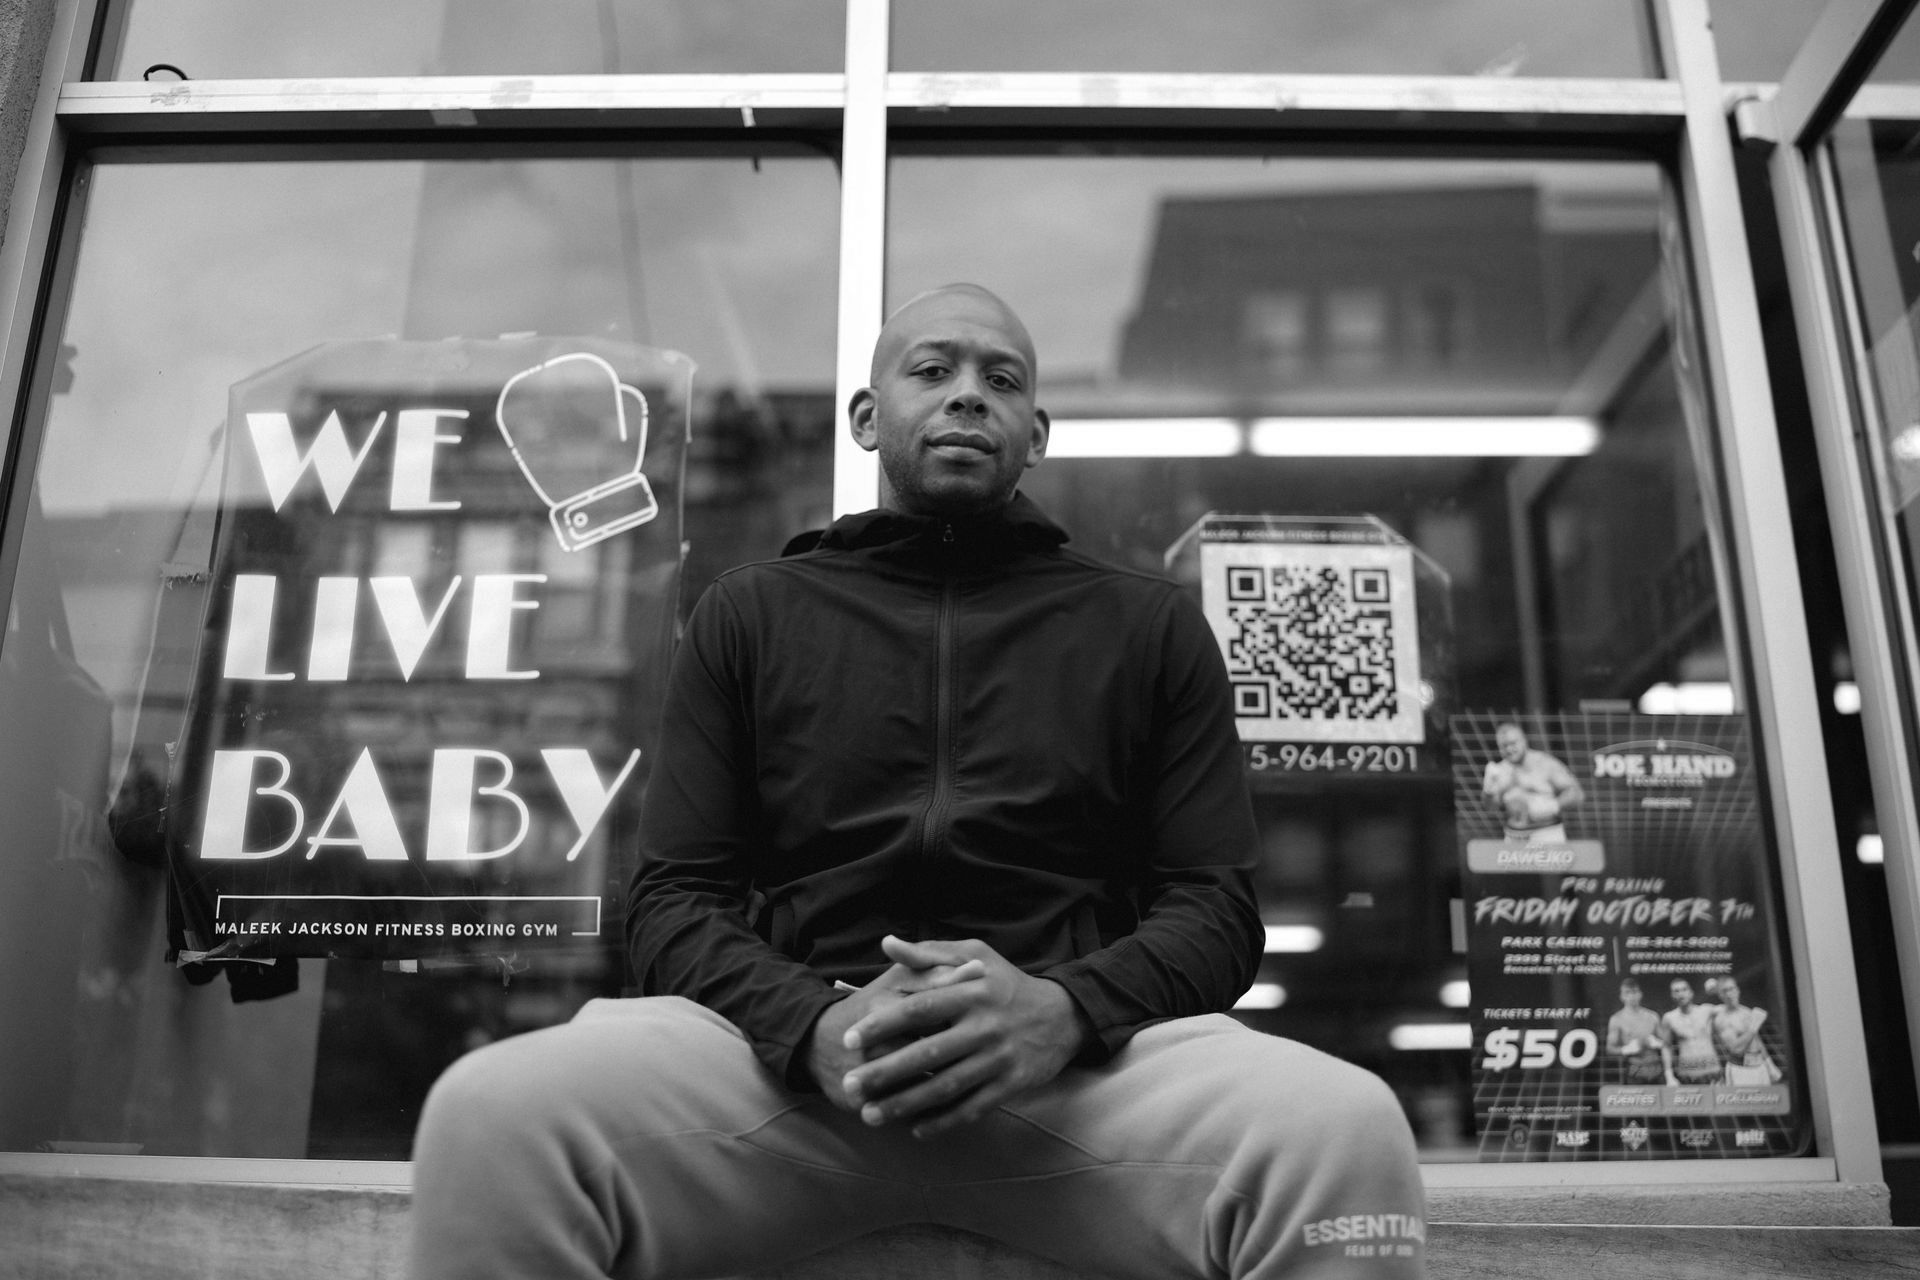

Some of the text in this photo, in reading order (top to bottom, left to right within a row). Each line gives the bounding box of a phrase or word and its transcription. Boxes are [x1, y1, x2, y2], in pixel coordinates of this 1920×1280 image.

[246, 408, 470, 515] WE
[223, 574, 548, 682] LIVE
[1594, 754, 1736, 779] JOE HAND
[200, 745, 641, 862] BABY
[1560, 876, 1665, 893] PRO BOXING
[1474, 895, 1579, 928] FRIDAY
[1586, 895, 1713, 928] OCTOBER
[214, 922, 559, 938] MALEEK JACKSON FITNESS BOXING GYM
[1545, 935, 1605, 949] CASINO
[1483, 1007, 1592, 1020] TICKETS START AT
[1481, 1026, 1598, 1073] $50
[1379, 1245, 1393, 1257] OF
